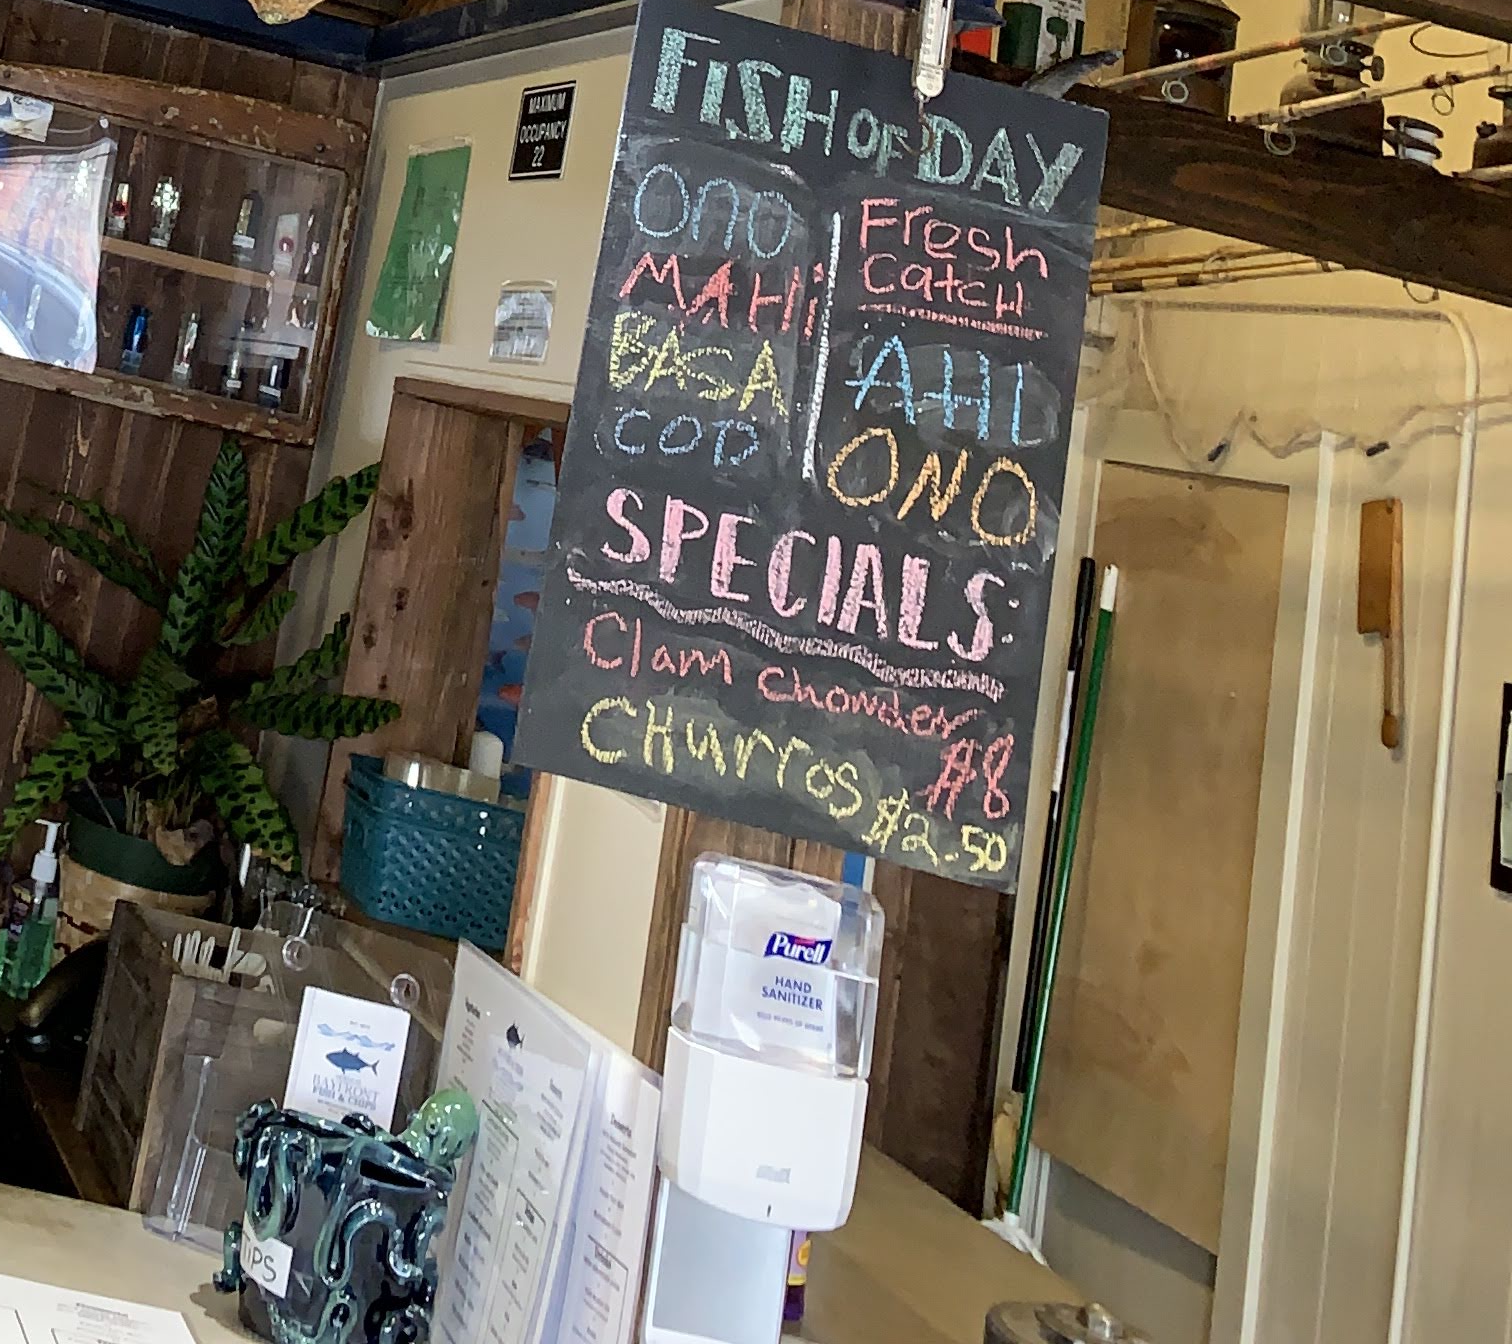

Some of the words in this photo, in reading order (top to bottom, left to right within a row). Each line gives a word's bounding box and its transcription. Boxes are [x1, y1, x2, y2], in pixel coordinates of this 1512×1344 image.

[519, 119, 568, 144] OCCUPANCY
[528, 92, 567, 115] MAXIMUM
[650, 27, 838, 156] FISH
[847, 108, 907, 178] OF
[915, 114, 1085, 213] DAY
[531, 144, 545, 167] 22
[858, 197, 1048, 280] Fresh
[609, 311, 789, 417] BASA
[845, 334, 1023, 447] AHI
[614, 408, 760, 468] COD
[827, 427, 1037, 546] ONO
[583, 610, 734, 685] Clam
[917, 732, 1015, 820] $8
[862, 788, 1010, 873] $2.50
[761, 986, 823, 1012] SANITIZER
[775, 975, 812, 994] HAND
